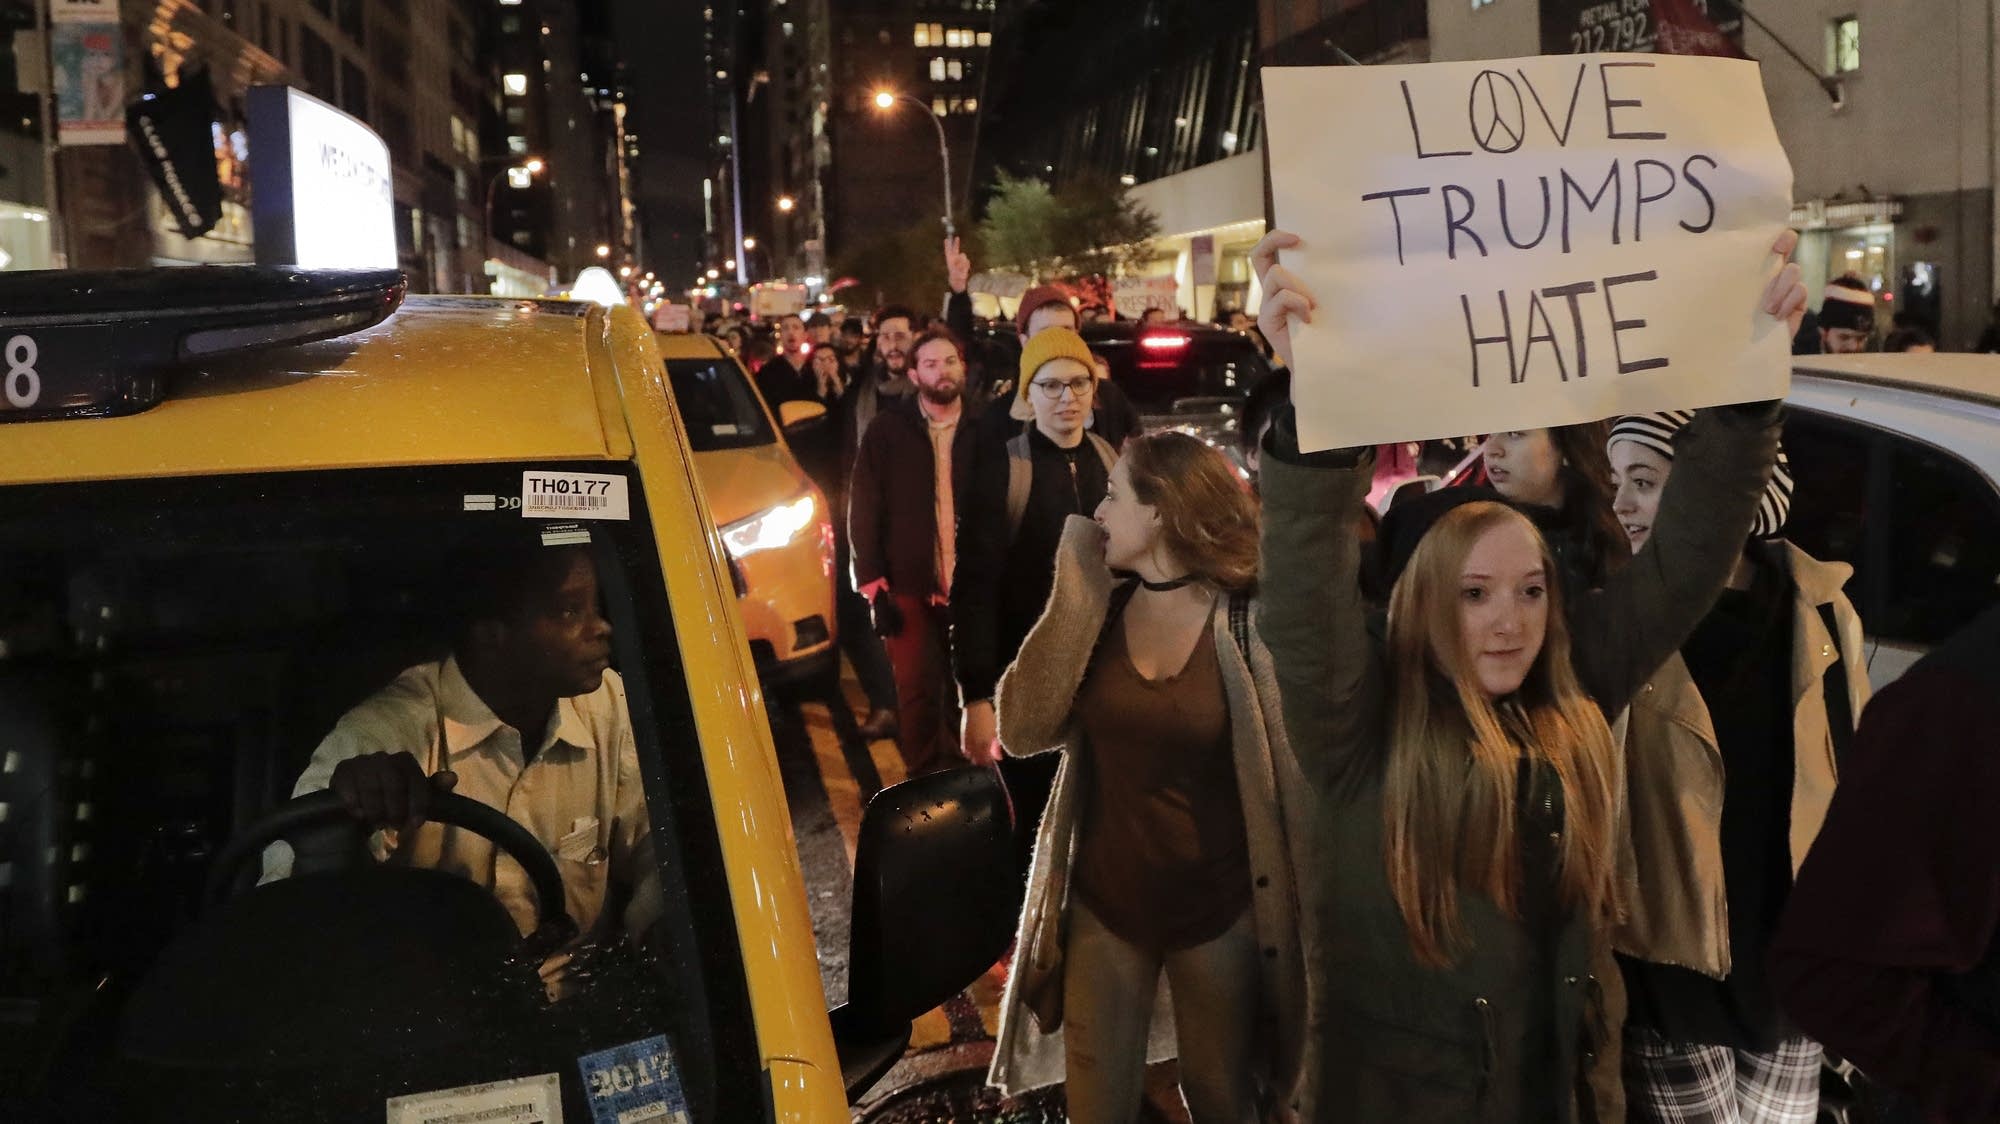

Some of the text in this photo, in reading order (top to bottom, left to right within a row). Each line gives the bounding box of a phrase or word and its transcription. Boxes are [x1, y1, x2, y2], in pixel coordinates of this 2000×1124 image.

[1580, 2, 1620, 26] RETAIL
[1400, 62, 1666, 158] LOVE
[1362, 154, 1717, 266] TRUMPS
[1116, 295, 1176, 311] PRESIDENT
[1461, 270, 1669, 387] HATE
[5, 334, 40, 408] 8
[529, 479, 610, 495] TH0177
